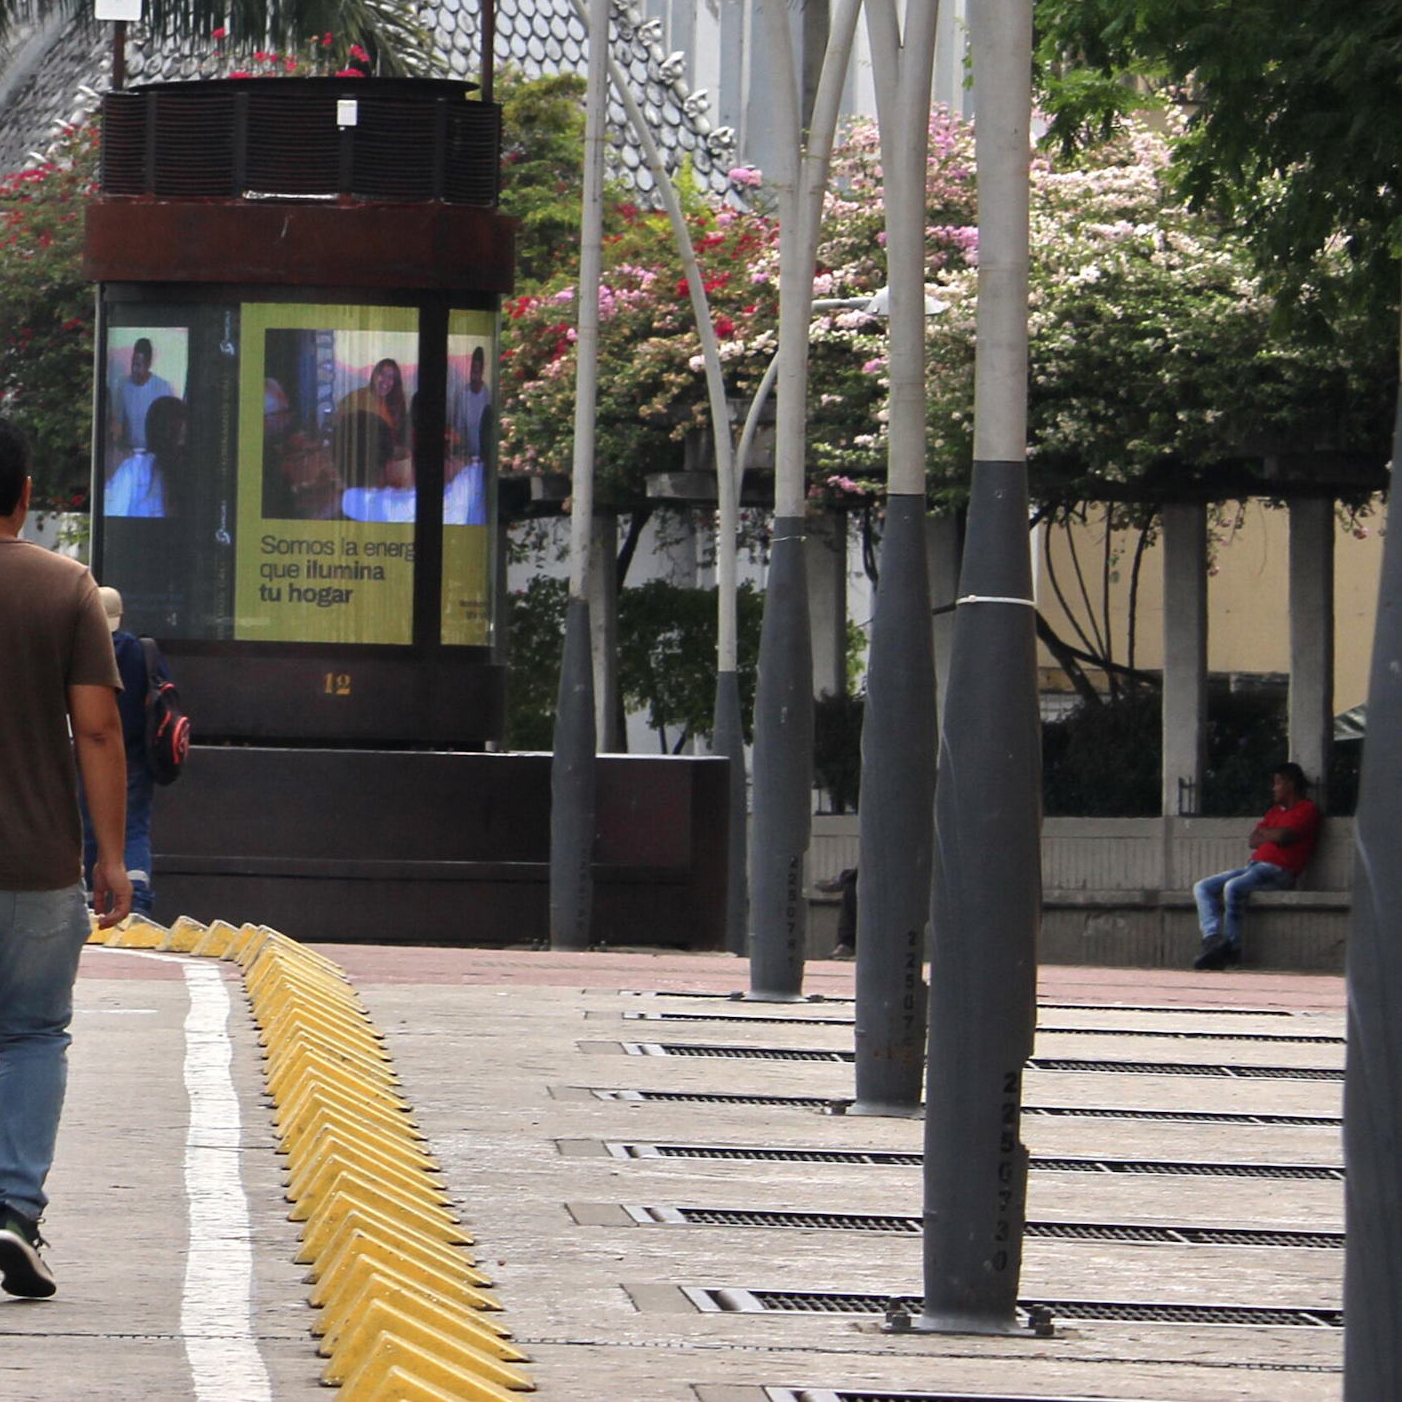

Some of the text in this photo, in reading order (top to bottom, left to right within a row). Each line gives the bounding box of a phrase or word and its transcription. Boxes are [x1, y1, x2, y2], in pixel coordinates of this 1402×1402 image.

[261, 535, 416, 562] Somos la energ
[260, 559, 386, 582] que ilumina
[259, 583, 353, 608] tu hogar
[324, 673, 351, 695] 12
